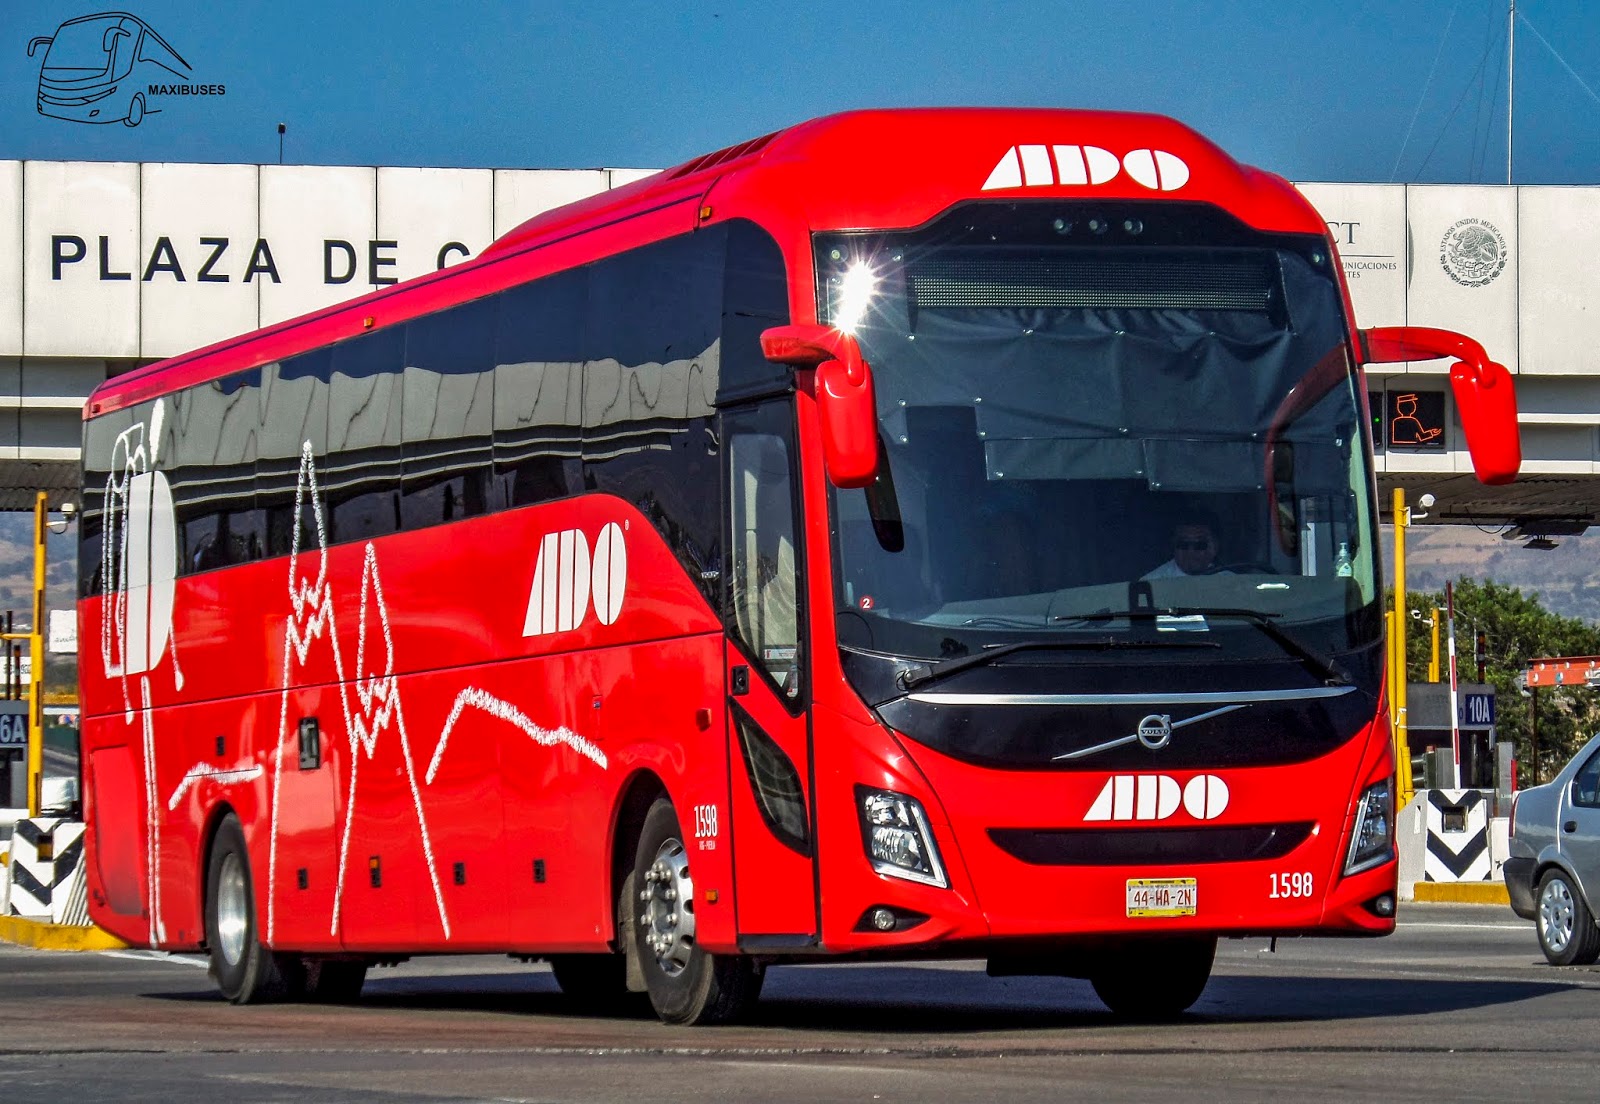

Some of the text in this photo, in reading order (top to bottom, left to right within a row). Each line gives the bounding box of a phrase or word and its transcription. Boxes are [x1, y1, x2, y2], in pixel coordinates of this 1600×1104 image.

[981, 144, 1190, 191] ADO
[1440, 218, 1506, 252] ESTADOS UNIDOS MEXICANOS
[51, 234, 281, 283] PLAZA
[323, 239, 399, 285] DE
[522, 521, 627, 638] ADO
[862, 597, 871, 609] 2
[1469, 696, 1491, 722] 10A
[1082, 774, 1230, 821] ADO
[693, 804, 718, 838] 1598
[1133, 889, 1192, 906] 44-HA-2N
[1269, 871, 1313, 899] 1598
